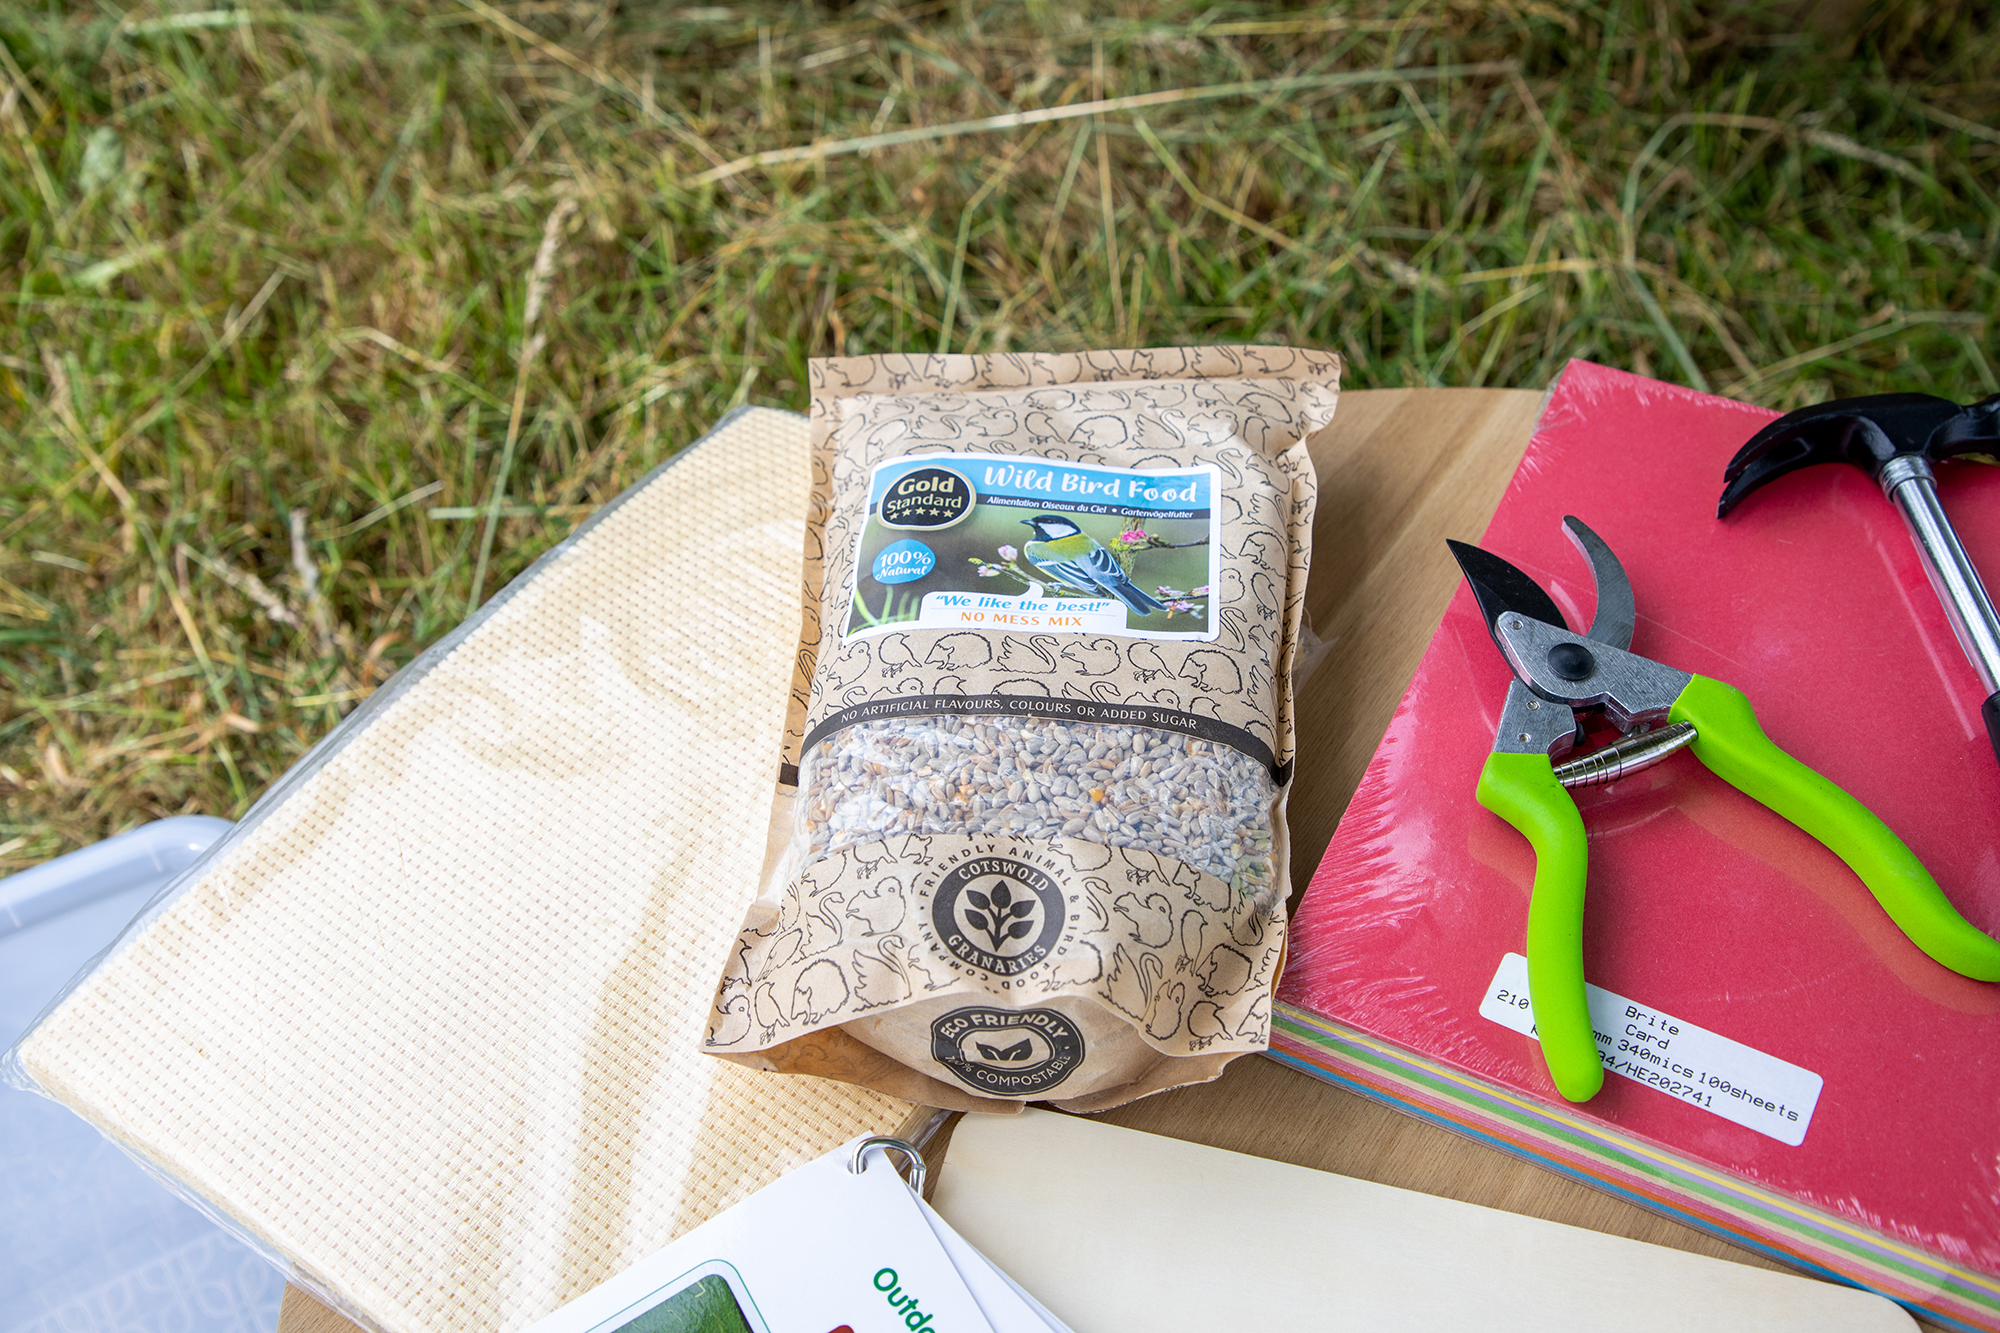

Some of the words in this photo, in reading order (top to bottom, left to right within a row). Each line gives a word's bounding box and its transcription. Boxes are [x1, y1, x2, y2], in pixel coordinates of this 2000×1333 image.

[897, 477, 955, 495] Gold
[984, 465, 1052, 492] Wild
[1061, 473, 1120, 498] Bird
[1129, 480, 1197, 502] Food
[887, 494, 962, 514] Standard
[987, 496, 1039, 509] Alimentation
[1042, 501, 1075, 511] Oiseaux
[1077, 504, 1088, 512] du
[1090, 505, 1107, 514] Ciel
[1121, 508, 1193, 519] Gartenvögelfutter
[880, 550, 931, 567] 100%
[875, 566, 927, 580] Natural
[978, 597, 1012, 609] like
[1019, 601, 1049, 611] the
[960, 612, 984, 621] NO
[993, 614, 1040, 626] MESS
[1049, 616, 1082, 626] MIX
[841, 711, 858, 723] NO
[861, 702, 929, 716] ARTIFICIAL
[935, 700, 1004, 709] FLAVOURS,
[1009, 700, 1071, 714] COLOURS
[1077, 706, 1095, 717] OR
[1100, 709, 1146, 720] ADDED
[1152, 712, 1197, 729] SUGAR
[919, 844, 995, 898] FRIENDLY
[958, 859, 1049, 891] COTSWOLD
[1009, 847, 1072, 886] ANIMAL
[1069, 895, 1078, 903] &
[1057, 914, 1080, 955] BIRD
[918, 922, 989, 981] COMPANY
[948, 934, 1047, 974] GRANARIES
[1001, 962, 1050, 989] FOOD
[941, 1018, 968, 1039] ECO
[970, 1013, 1069, 1040] FRIENDLY
[1625, 1006, 1680, 1036] Brite
[1625, 1024, 1670, 1050] Card
[1497, 989, 1529, 1009] 210
[1618, 1039, 1694, 1079] 340mics
[1699, 1072, 1799, 1122] 100sheets
